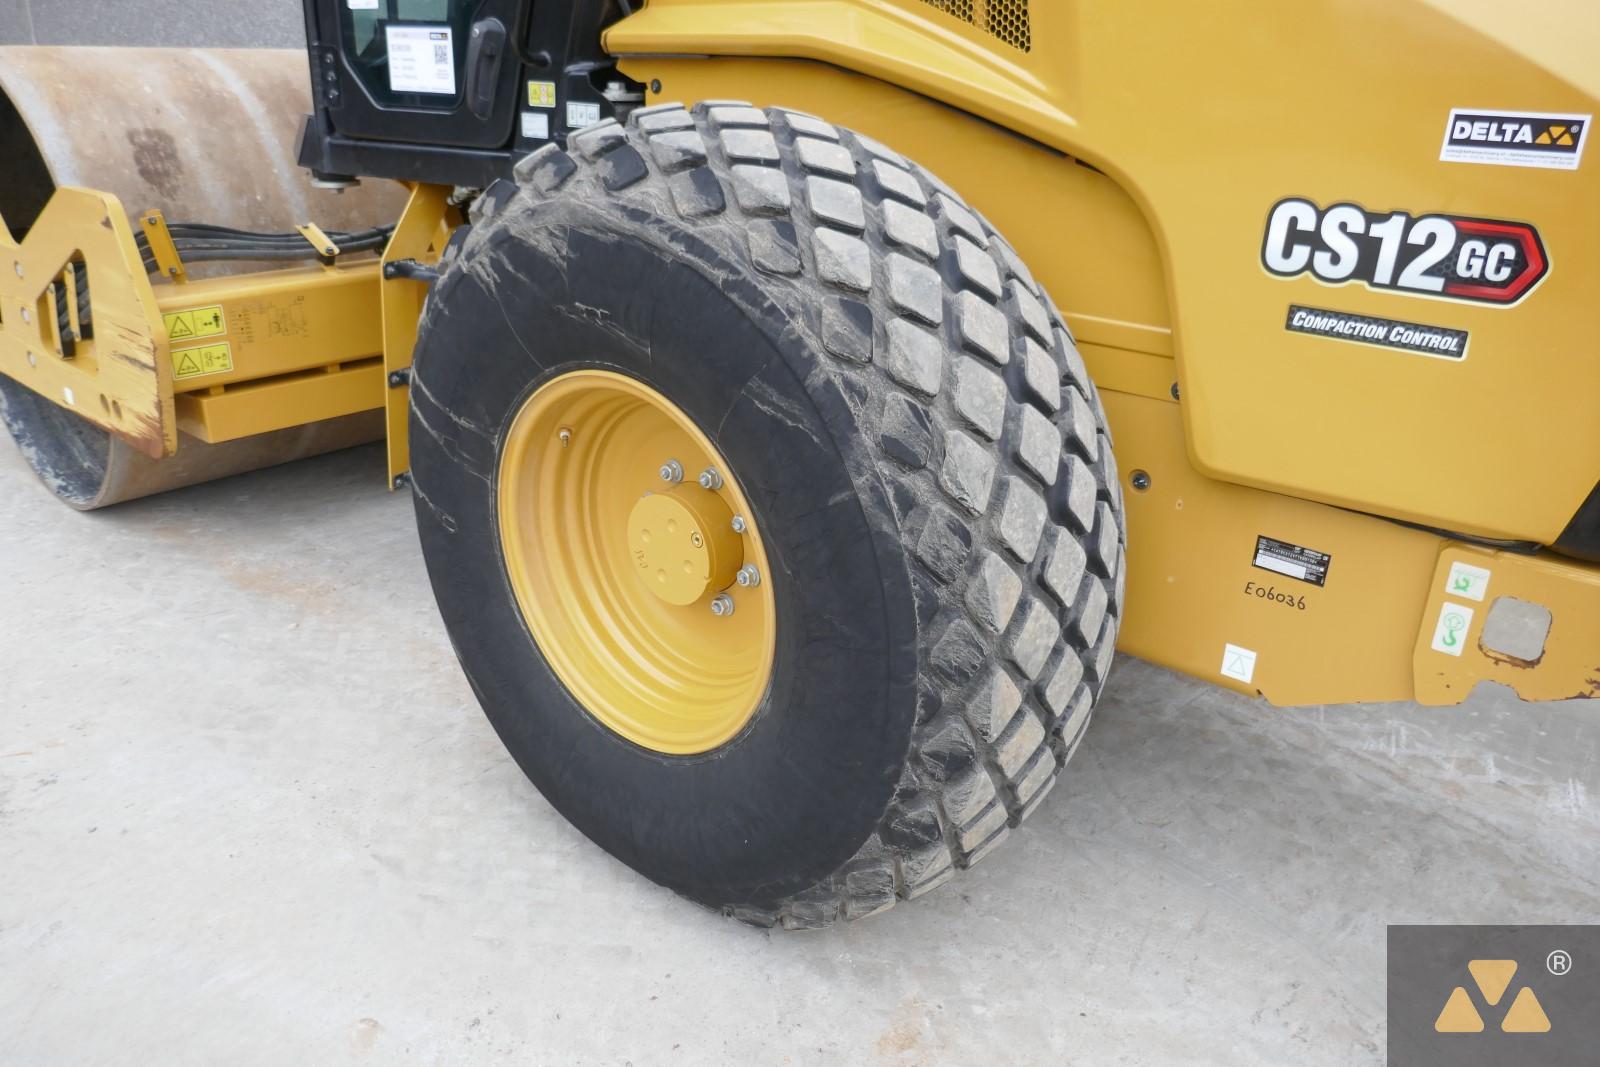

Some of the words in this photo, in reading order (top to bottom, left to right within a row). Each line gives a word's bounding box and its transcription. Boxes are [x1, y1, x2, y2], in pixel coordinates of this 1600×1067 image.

[1452, 119, 1533, 144] DELTA
[1264, 200, 1457, 293] CS12
[1455, 241, 1516, 282] GC
[1291, 310, 1388, 340] COMPACTION
[1388, 325, 1459, 352] CONTROL
[1244, 581, 1306, 610] E06036
